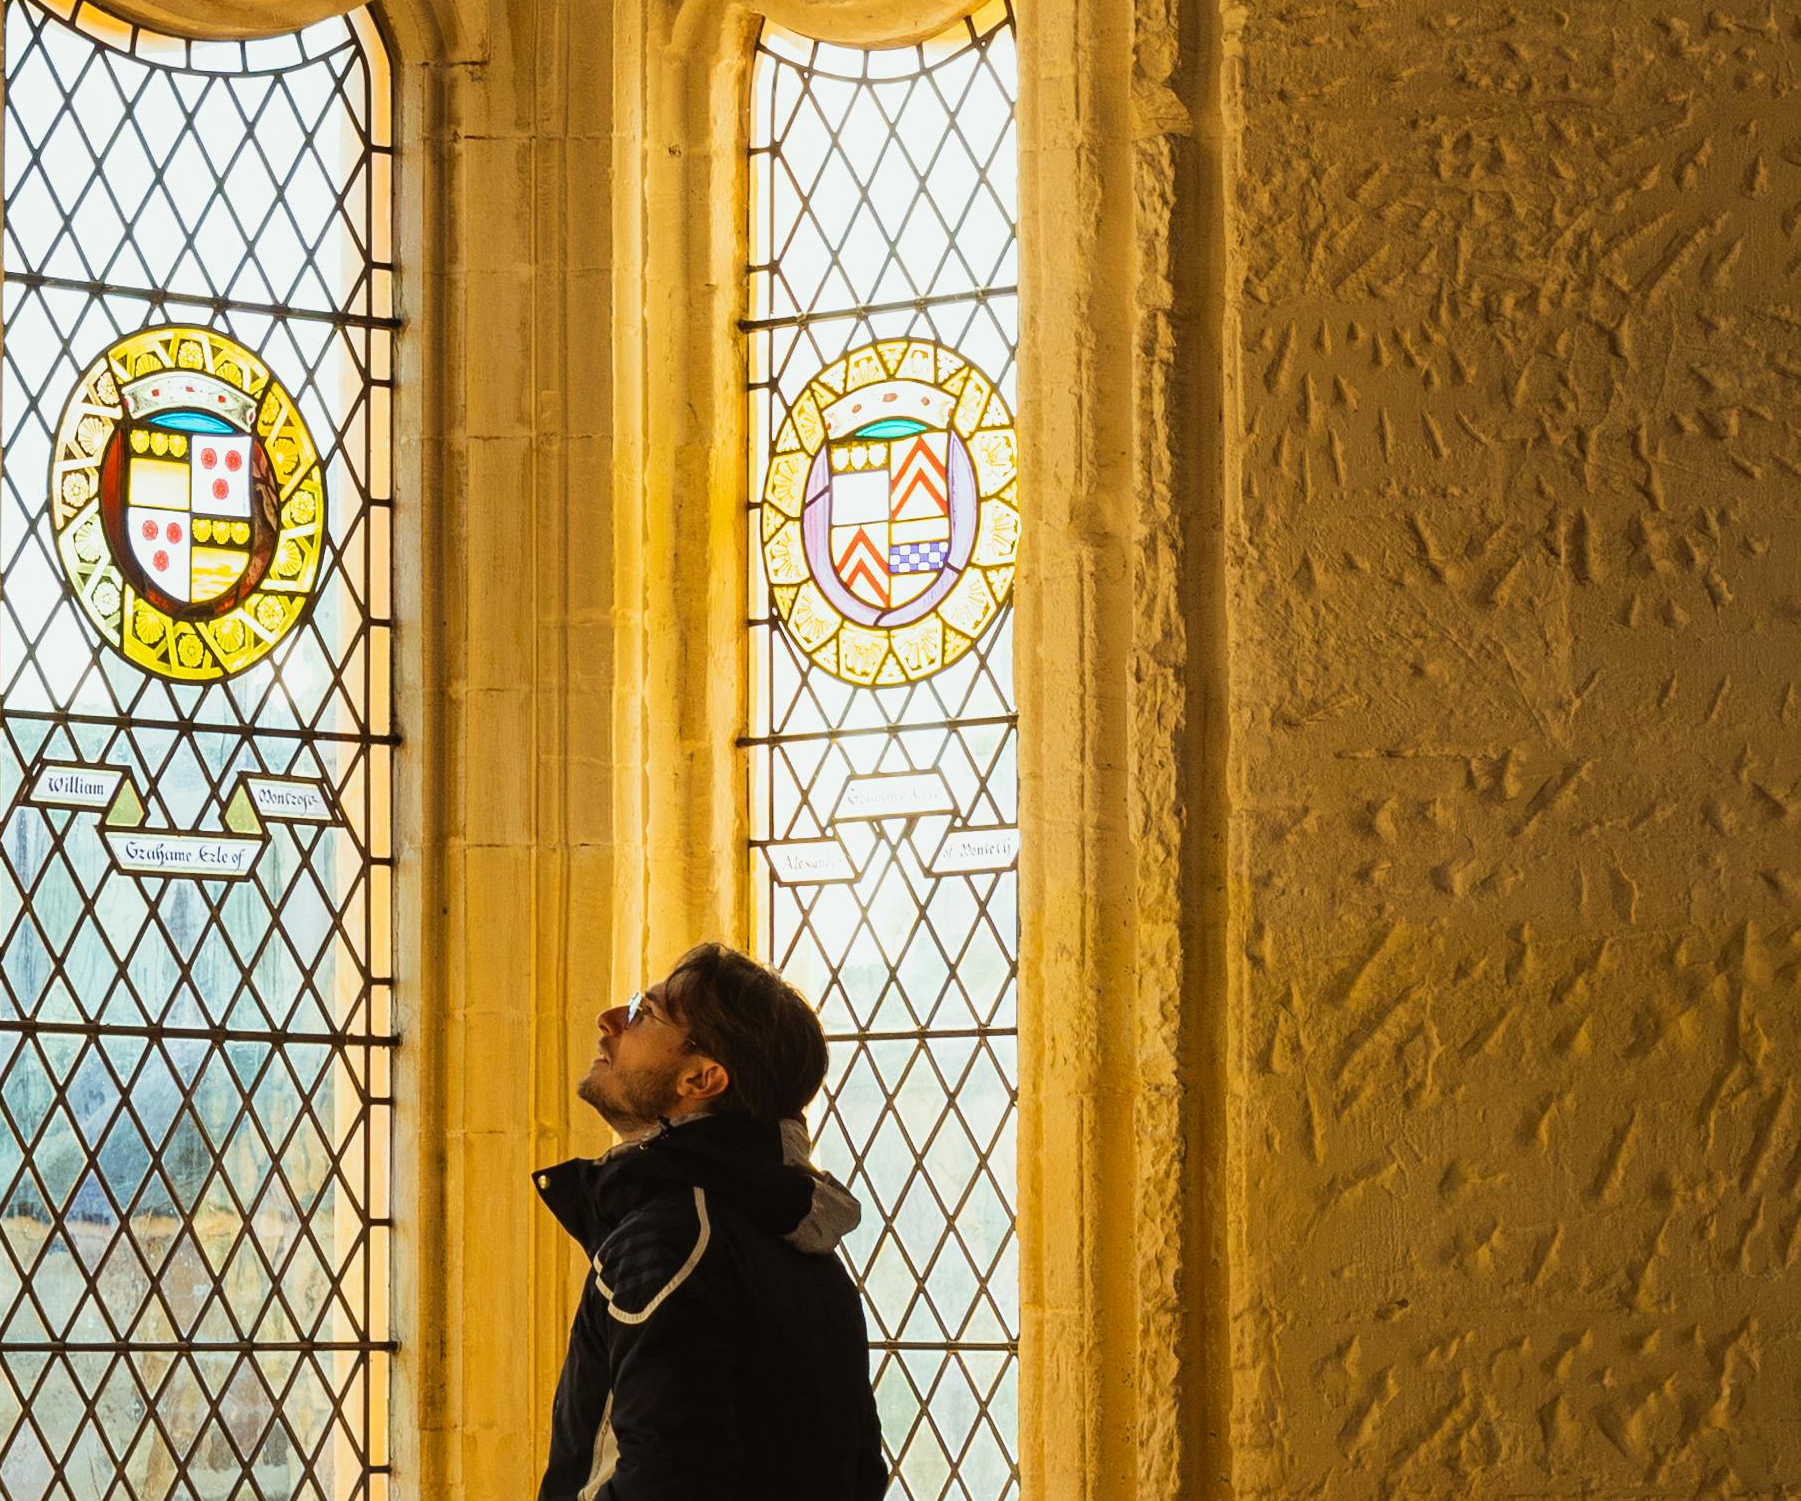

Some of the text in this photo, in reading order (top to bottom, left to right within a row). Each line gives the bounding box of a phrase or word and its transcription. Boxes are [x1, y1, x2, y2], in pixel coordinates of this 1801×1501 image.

[48, 775, 105, 796] William
[231, 847, 246, 871] of
[782, 852, 845, 871] Alexan
